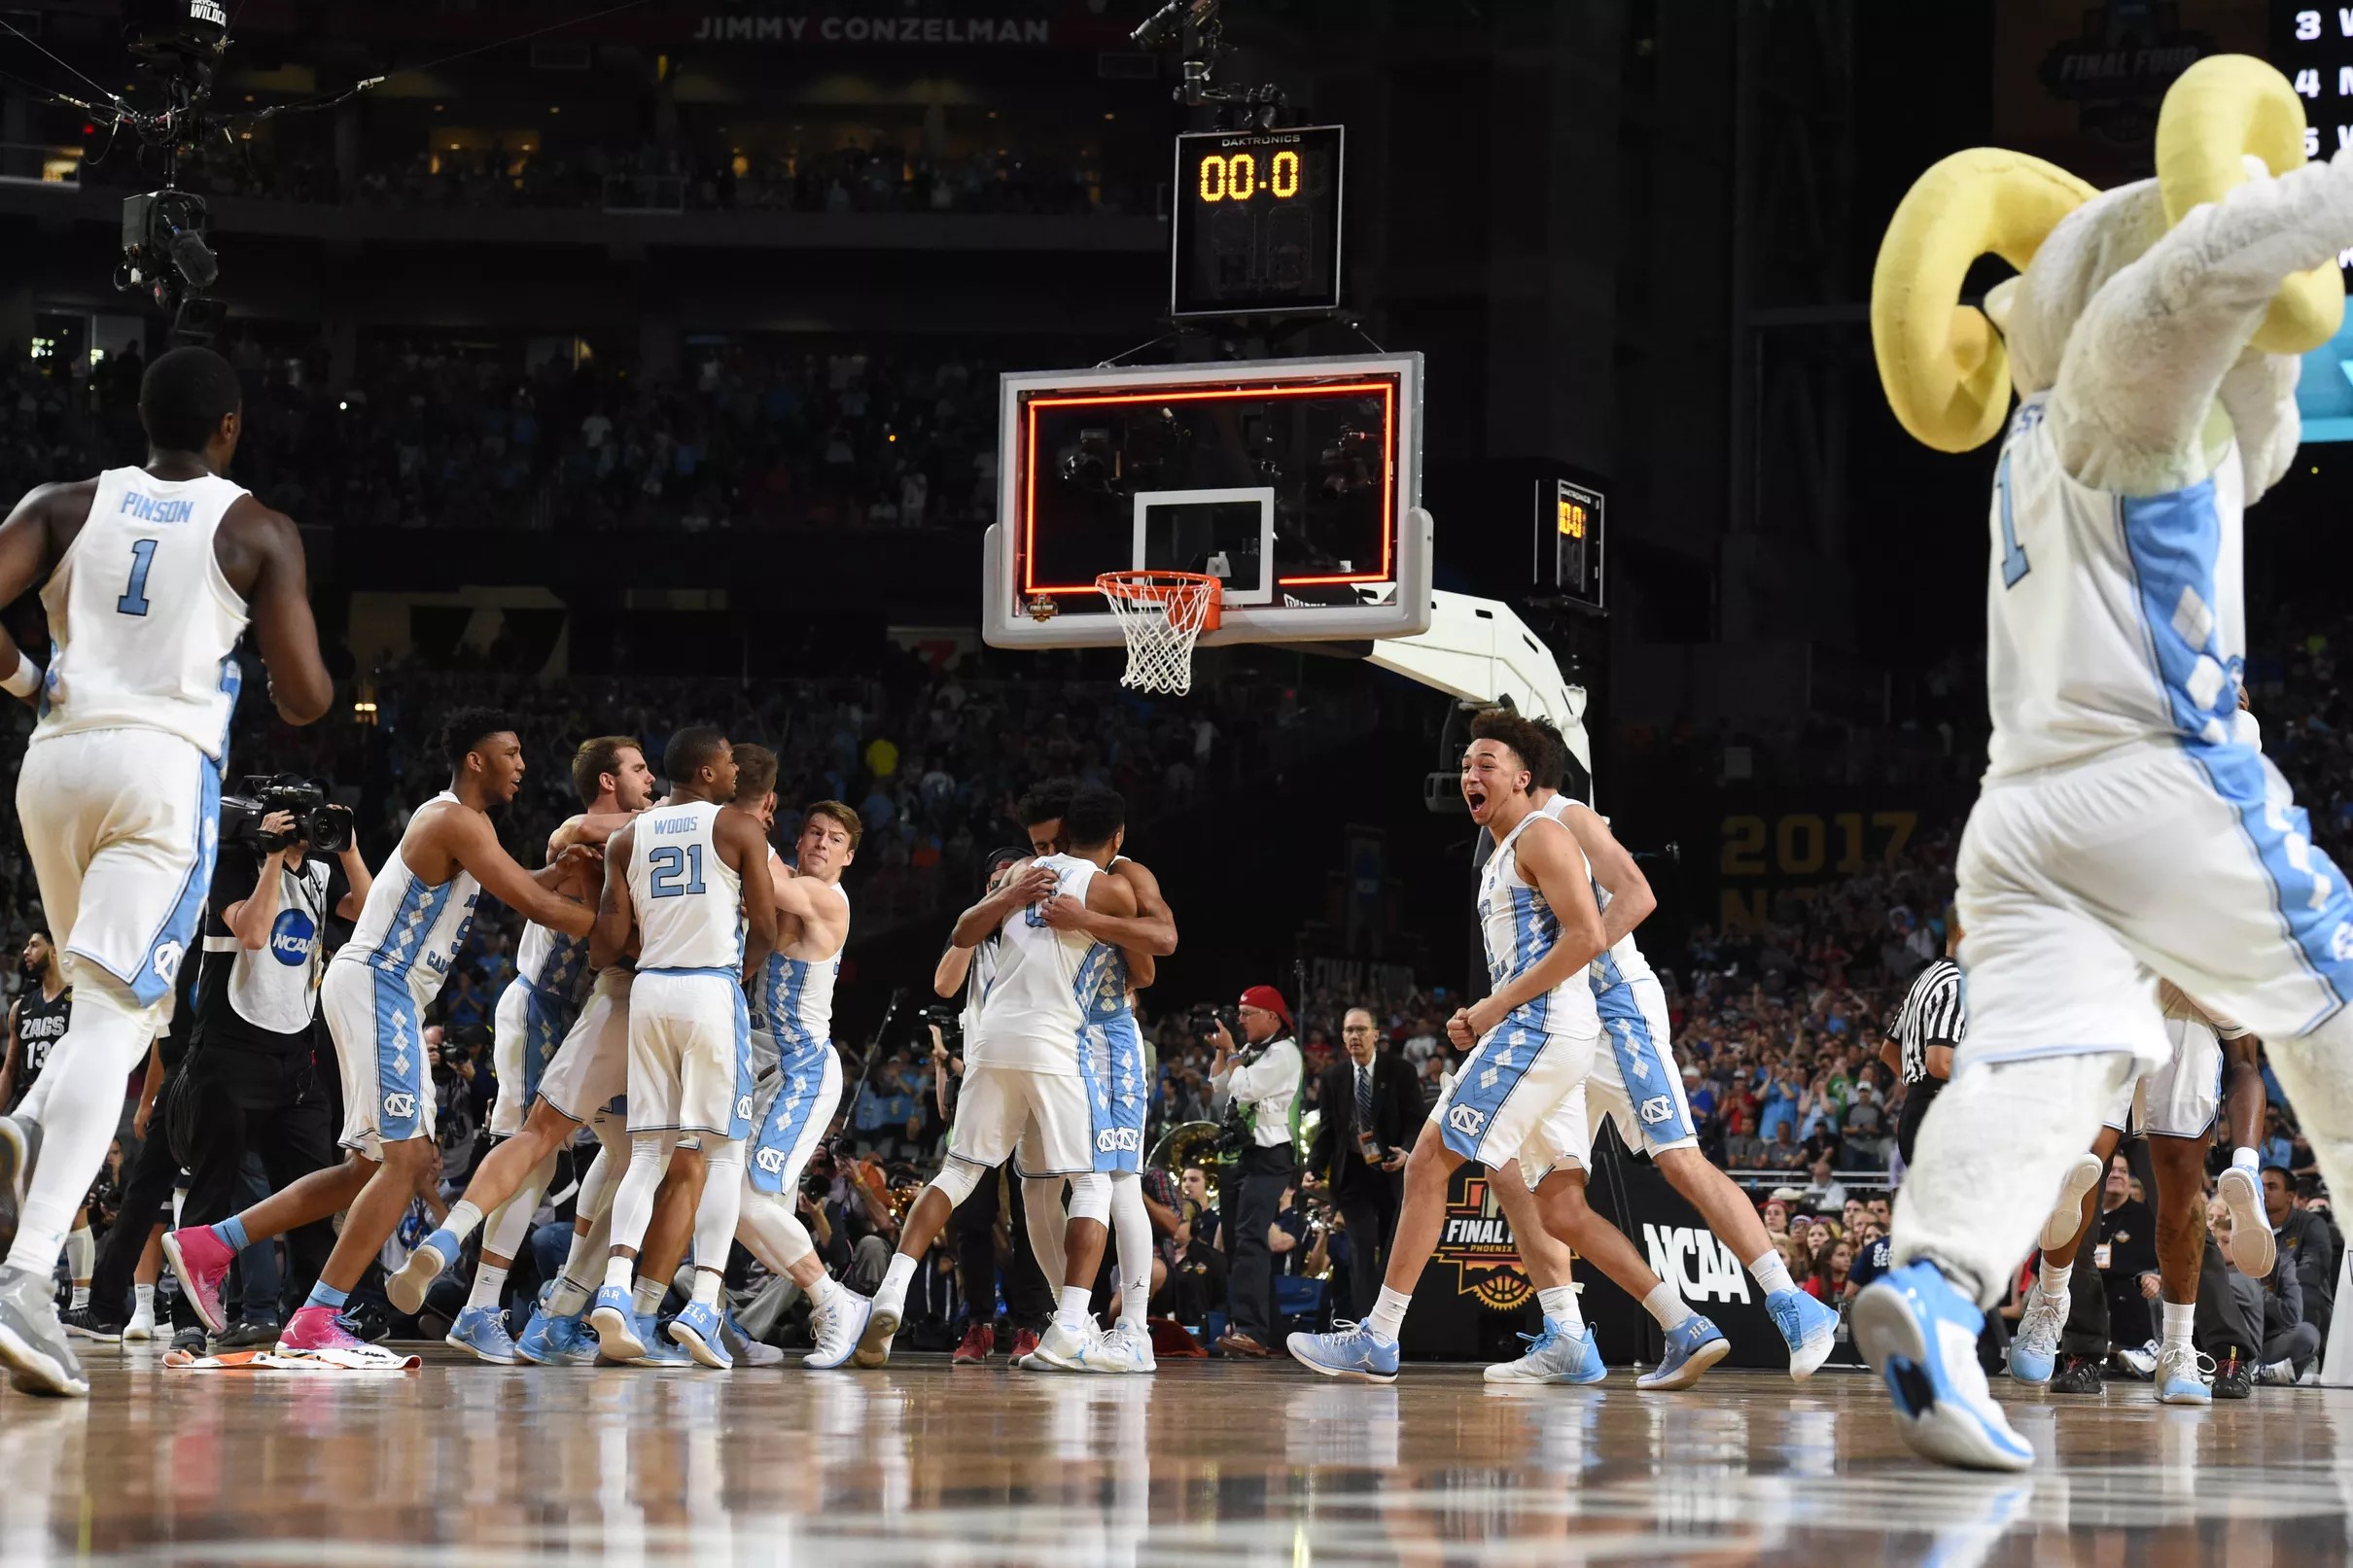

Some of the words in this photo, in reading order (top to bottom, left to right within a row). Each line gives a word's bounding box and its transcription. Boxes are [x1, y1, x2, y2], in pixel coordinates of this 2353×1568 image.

[693, 16, 807, 41] JIMMY
[821, 17, 1050, 43] CONZELMAN
[2295, 10, 2321, 41] 3
[2059, 52, 2126, 81] FINAL
[2294, 68, 2321, 98] 4
[1221, 134, 1301, 147] DAKTRONICS
[121, 490, 194, 523] PINSON
[117, 539, 158, 616] 1
[654, 816, 698, 834] WOODS
[1720, 811, 1918, 875] 2017
[650, 844, 706, 898] 21
[19, 1015, 66, 1041] ZAGS
[1446, 1219, 1503, 1243] FINAL
[1470, 1244, 1513, 1253] PHOENIX
[1642, 1222, 1751, 1305] NCAA
